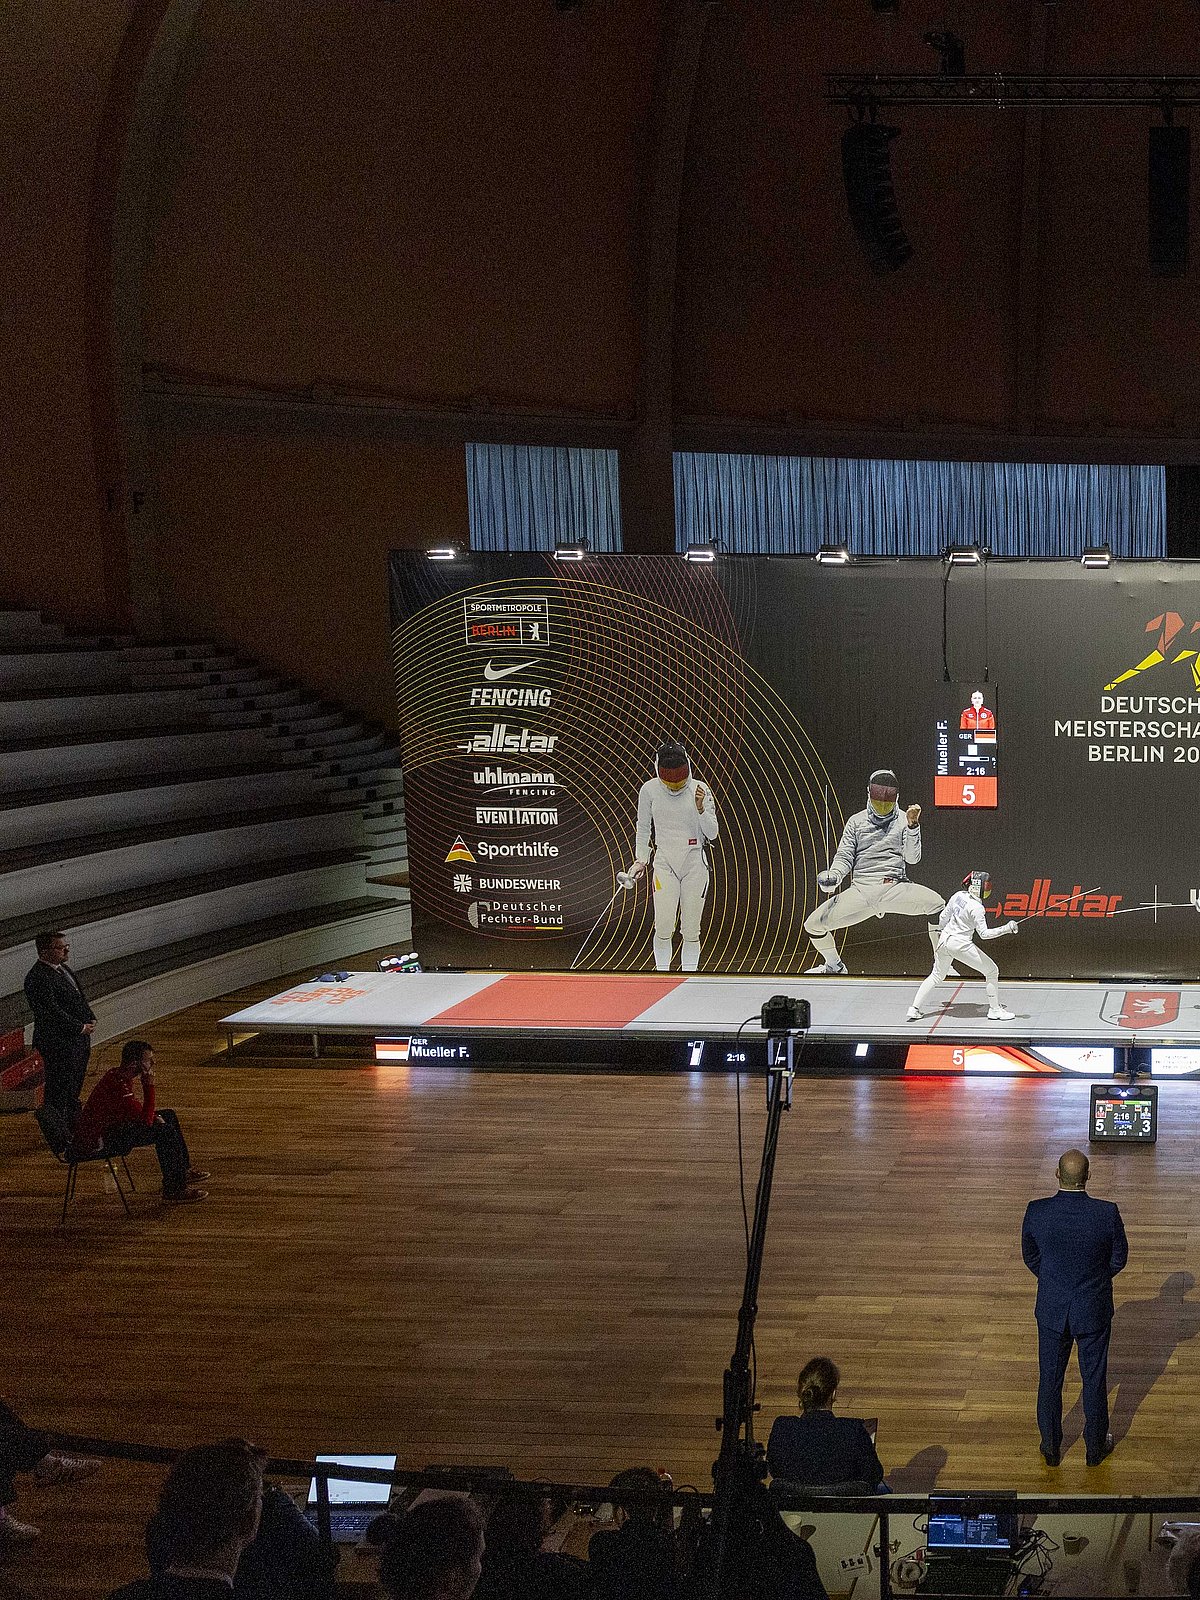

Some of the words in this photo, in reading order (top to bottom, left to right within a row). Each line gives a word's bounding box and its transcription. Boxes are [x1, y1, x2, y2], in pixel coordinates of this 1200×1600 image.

[470, 603, 542, 612] SPORTMETROPOLE
[472, 625, 516, 636] BERLIN
[470, 688, 551, 706] FENCING
[937, 720, 948, 729] F.
[472, 723, 558, 753] allstar
[937, 733, 948, 775] Mueller
[1088, 745, 1164, 763] BERLIN
[474, 767, 555, 784] uhlmann
[966, 767, 985, 775] 2:16
[962, 785, 975, 804] 5
[478, 841, 559, 859] Sporthilfe
[479, 878, 561, 890] BUNDESWEHR
[1003, 879, 1123, 918] allstar
[493, 902, 562, 911] Deutscher
[481, 914, 563, 924] Fechter-Bund
[411, 1046, 456, 1057] Mueller
[459, 1047, 470, 1057] F.
[952, 1050, 964, 1065] 5
[1095, 1119, 1104, 1131] 5
[1142, 1120, 1151, 1132] 3
